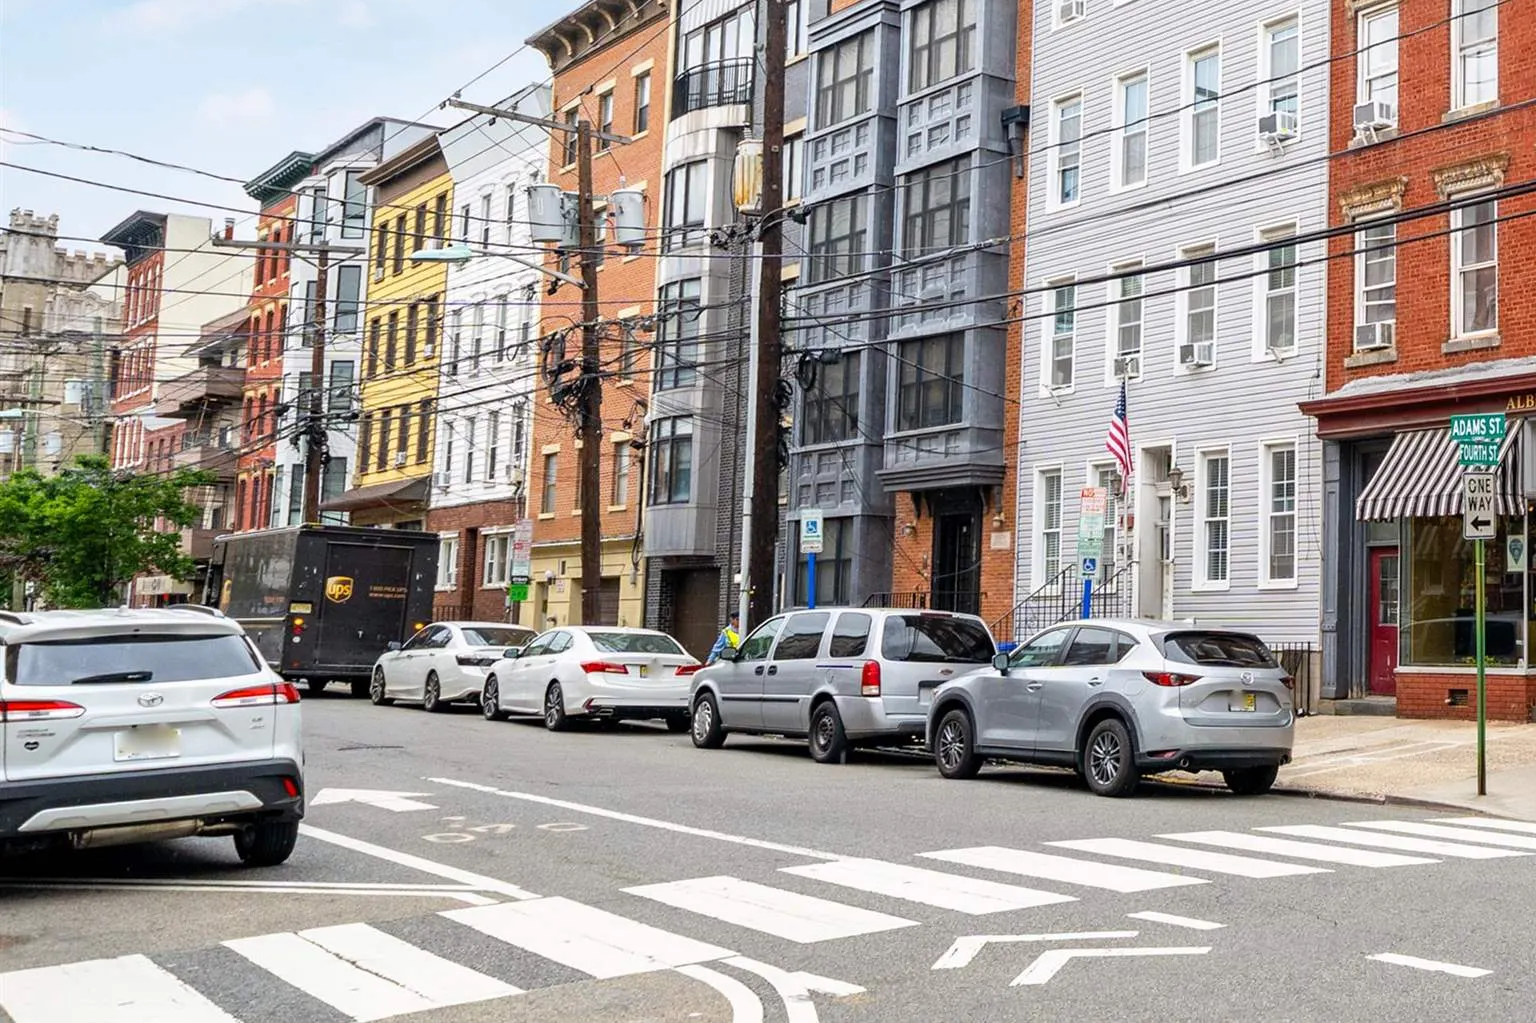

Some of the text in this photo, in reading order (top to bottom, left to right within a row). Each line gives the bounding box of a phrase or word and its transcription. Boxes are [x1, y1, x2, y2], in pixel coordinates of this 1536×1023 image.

[1452, 418, 1503, 436] ADAMS ST.
[1459, 444, 1487, 461] FOURTH
[1468, 478, 1491, 494] ONE
[1468, 496, 1491, 512] WAY
[329, 584, 352, 599] ups
